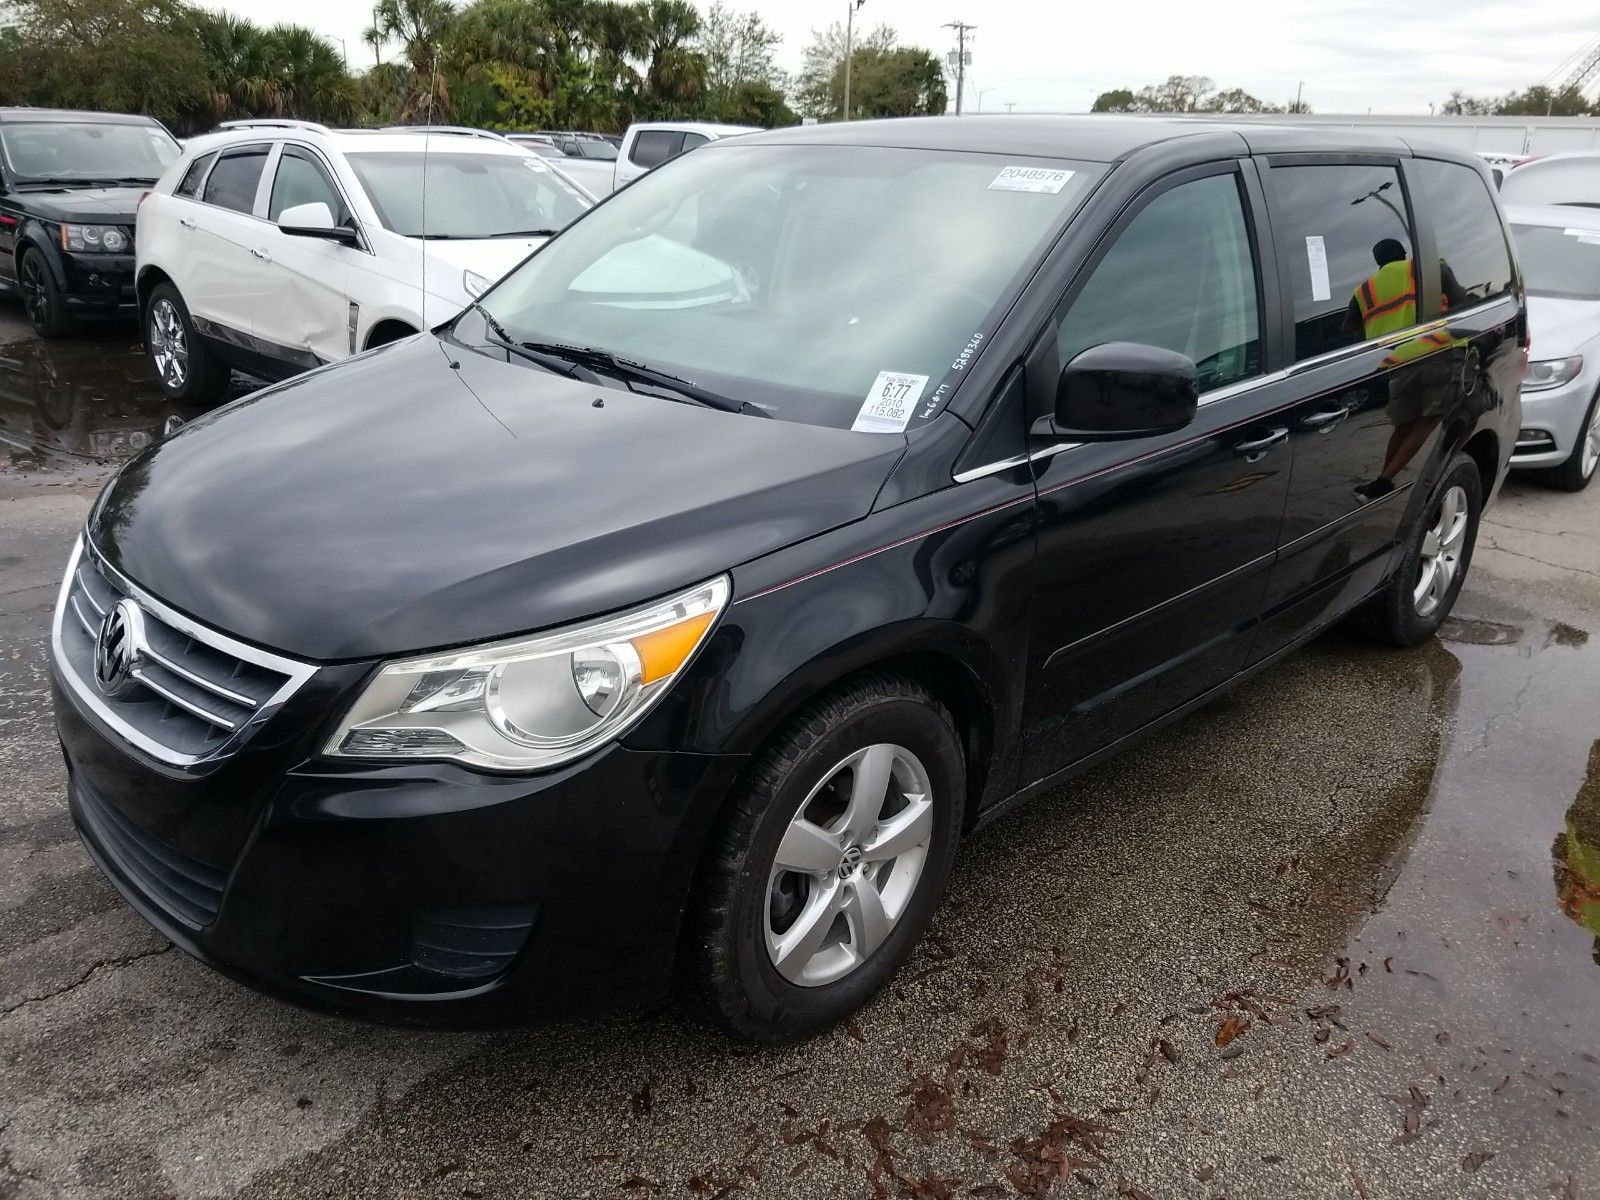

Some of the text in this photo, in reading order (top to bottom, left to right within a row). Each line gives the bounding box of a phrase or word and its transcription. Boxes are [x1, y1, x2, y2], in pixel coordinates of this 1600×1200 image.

[1000, 168, 1066, 182] 2048576
[952, 332, 984, 371] 5288360
[882, 382, 912, 399] 6:77
[880, 398, 903, 408] 2010
